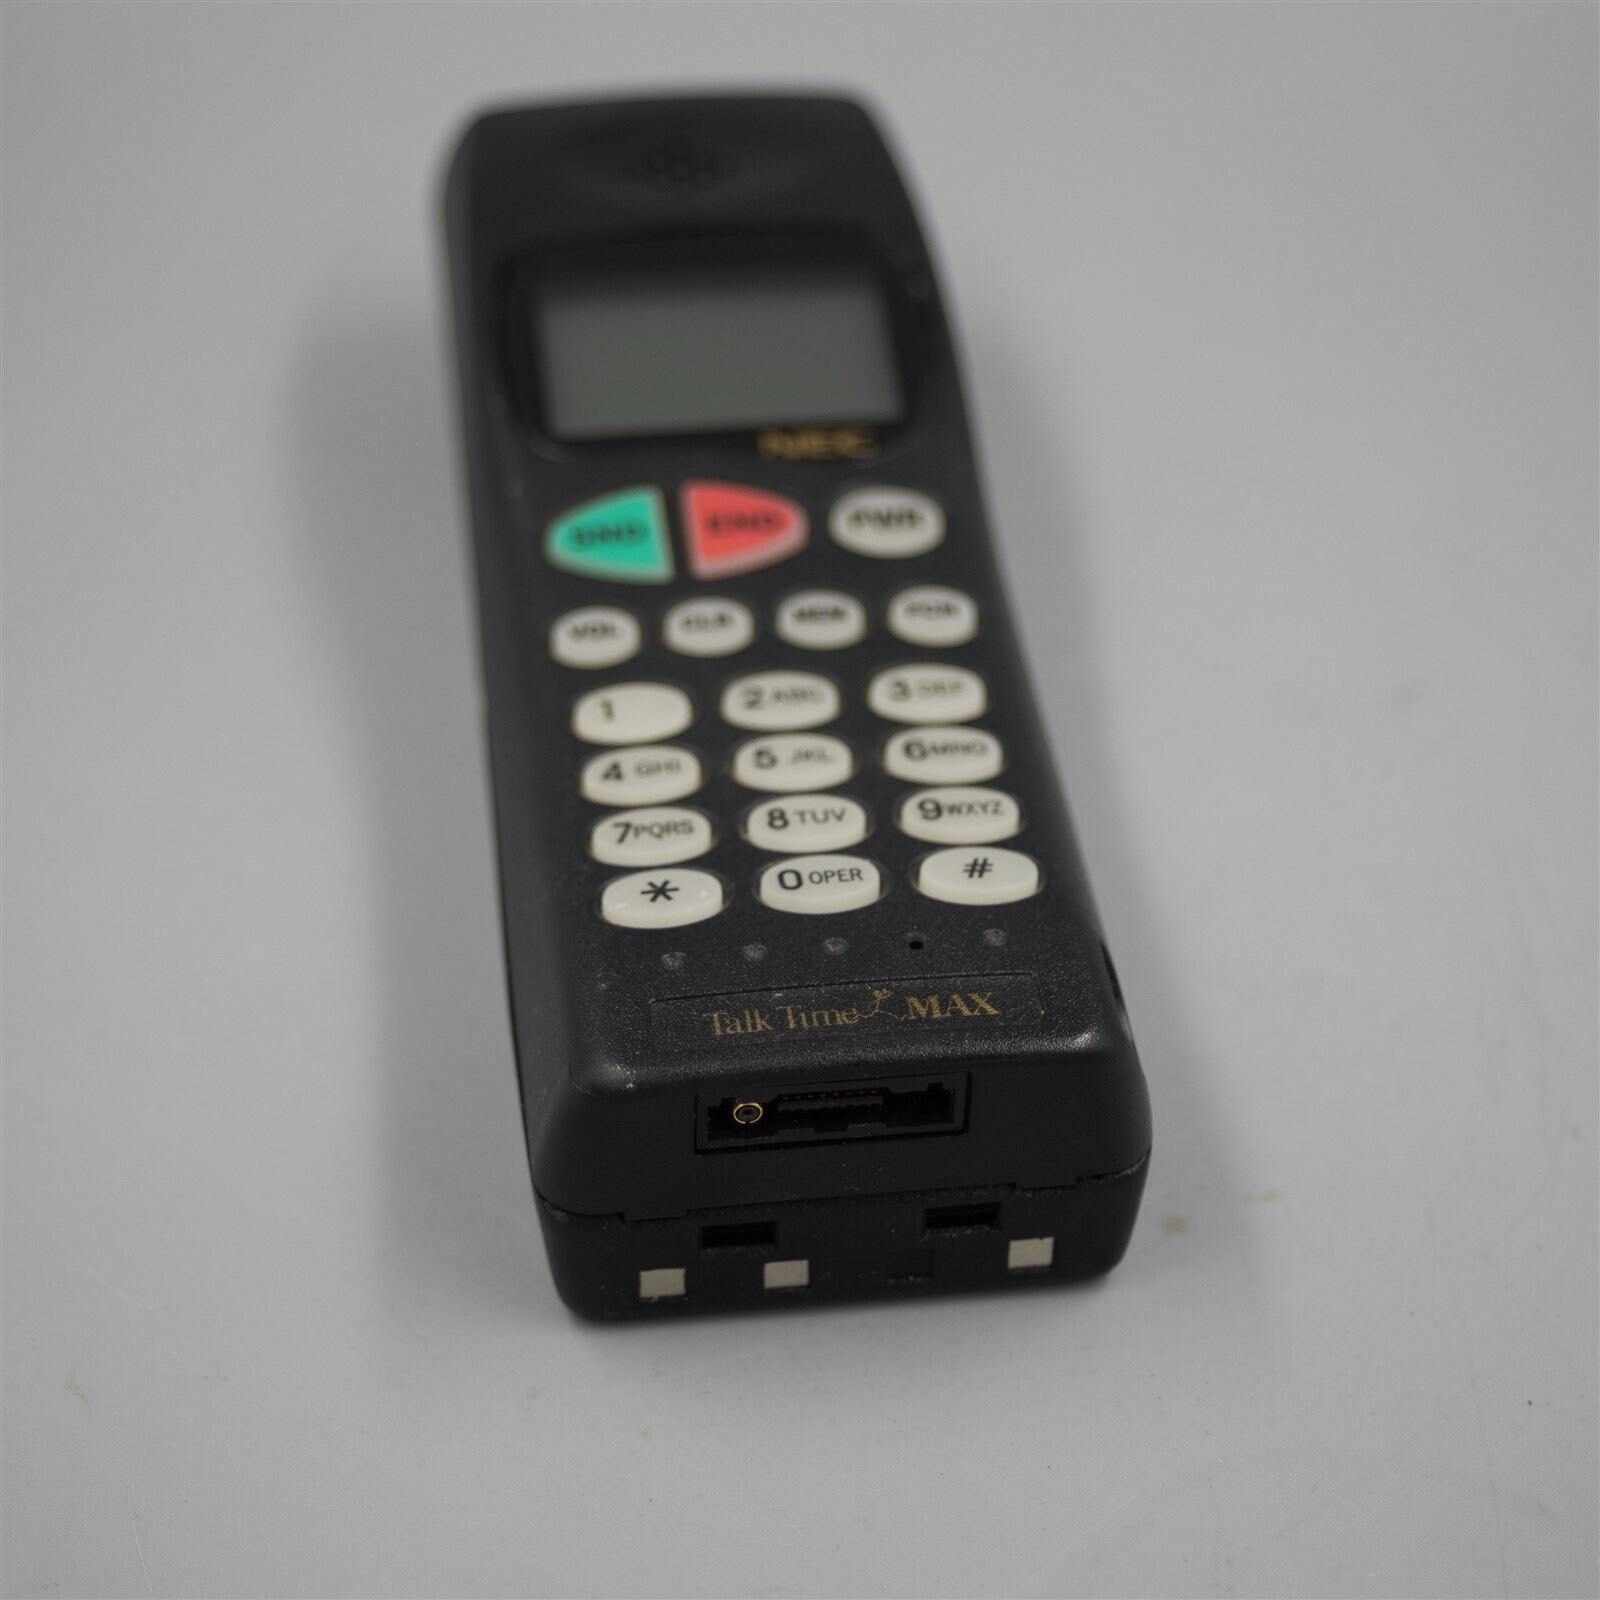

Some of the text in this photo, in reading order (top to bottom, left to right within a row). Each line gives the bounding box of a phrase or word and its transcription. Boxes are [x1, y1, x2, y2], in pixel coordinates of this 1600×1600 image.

[743, 686, 764, 711] 2
[891, 679, 911, 702] 3
[599, 698, 614, 721] 1
[754, 747, 778, 770] 5
[904, 739, 928, 761] 6
[602, 760, 681, 783] 4 GHI
[767, 807, 847, 830] 8 TUV
[918, 798, 1006, 822] 9 WXYZ
[614, 819, 695, 845] 7 PQRS
[808, 867, 864, 885] OPER
[702, 1008, 773, 1037] Talk
[904, 992, 1000, 1020] MAX
